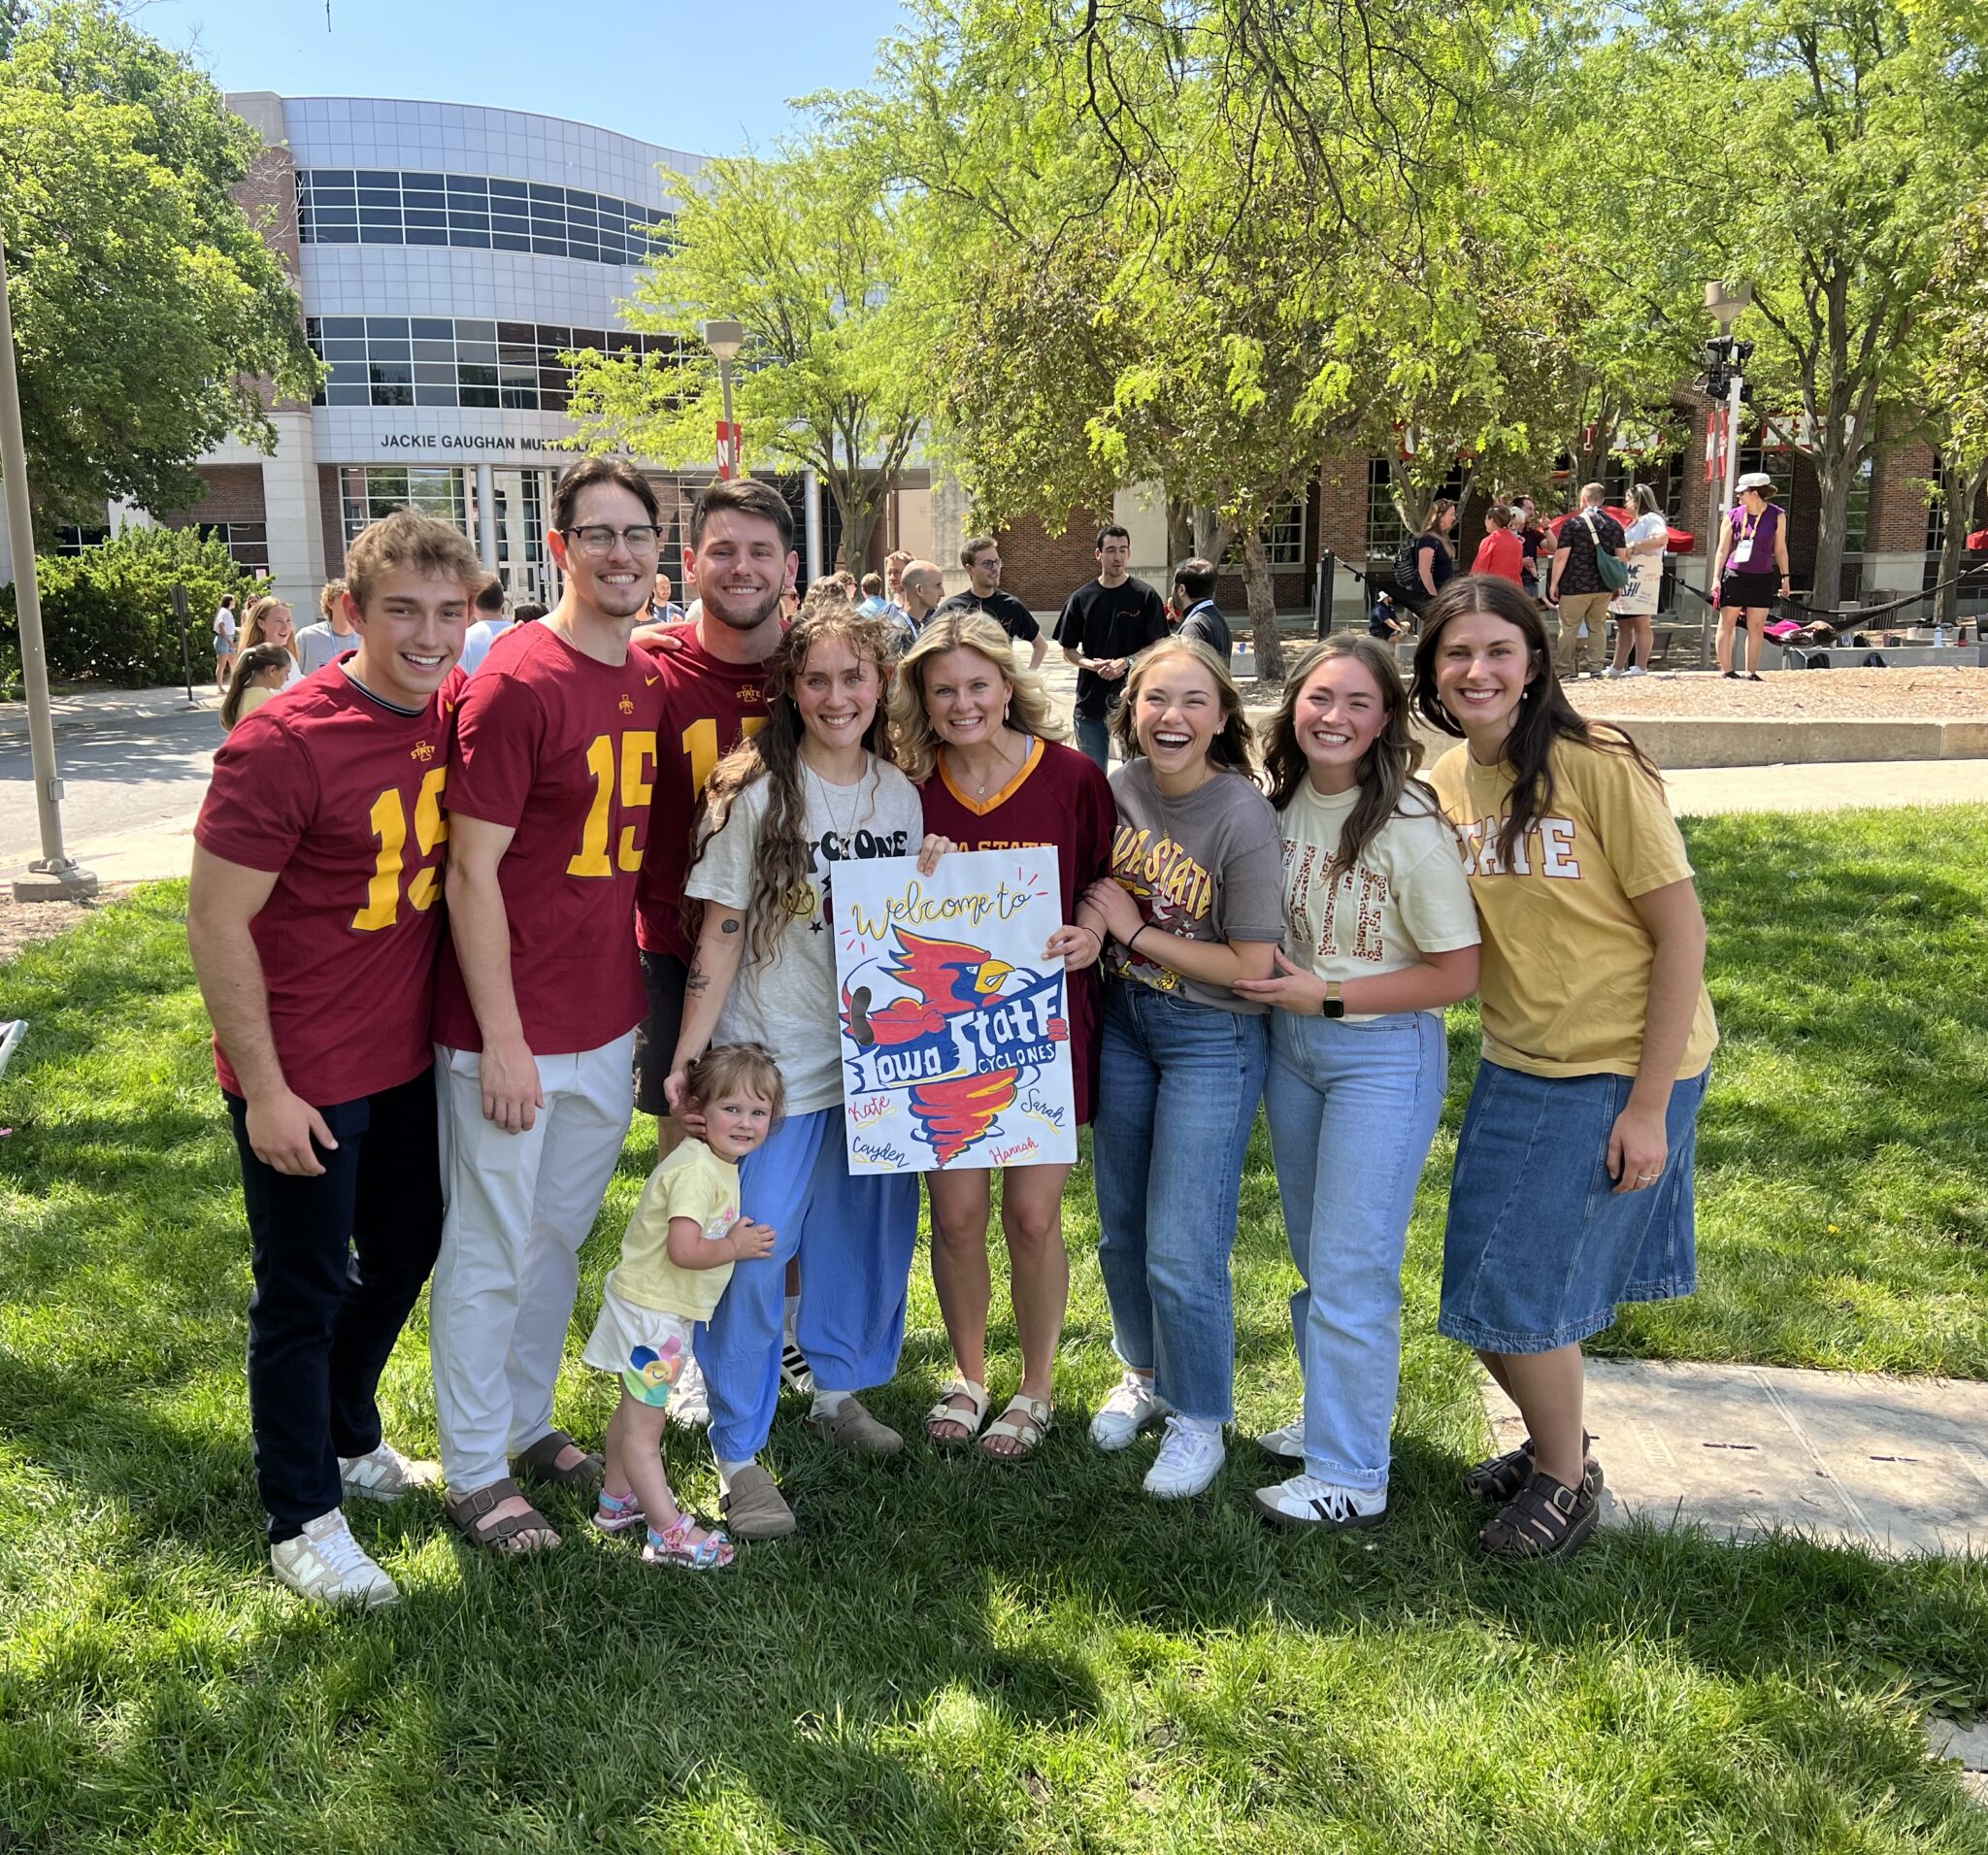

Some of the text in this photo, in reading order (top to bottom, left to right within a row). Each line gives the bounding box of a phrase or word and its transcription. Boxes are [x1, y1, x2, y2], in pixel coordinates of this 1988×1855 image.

[381, 434, 436, 447] JACKIE
[442, 435, 515, 449] GAUGHAN
[565, 731, 658, 878] 15
[1455, 814, 1581, 879] TATE
[1143, 838, 1212, 921] STATE
[850, 879, 1032, 941] Welcome to
[977, 1043, 1056, 1075] CYCLONES
[847, 1088, 1066, 1128] Kate Sarah
[852, 1136, 1040, 1169] Cayden Hannah
